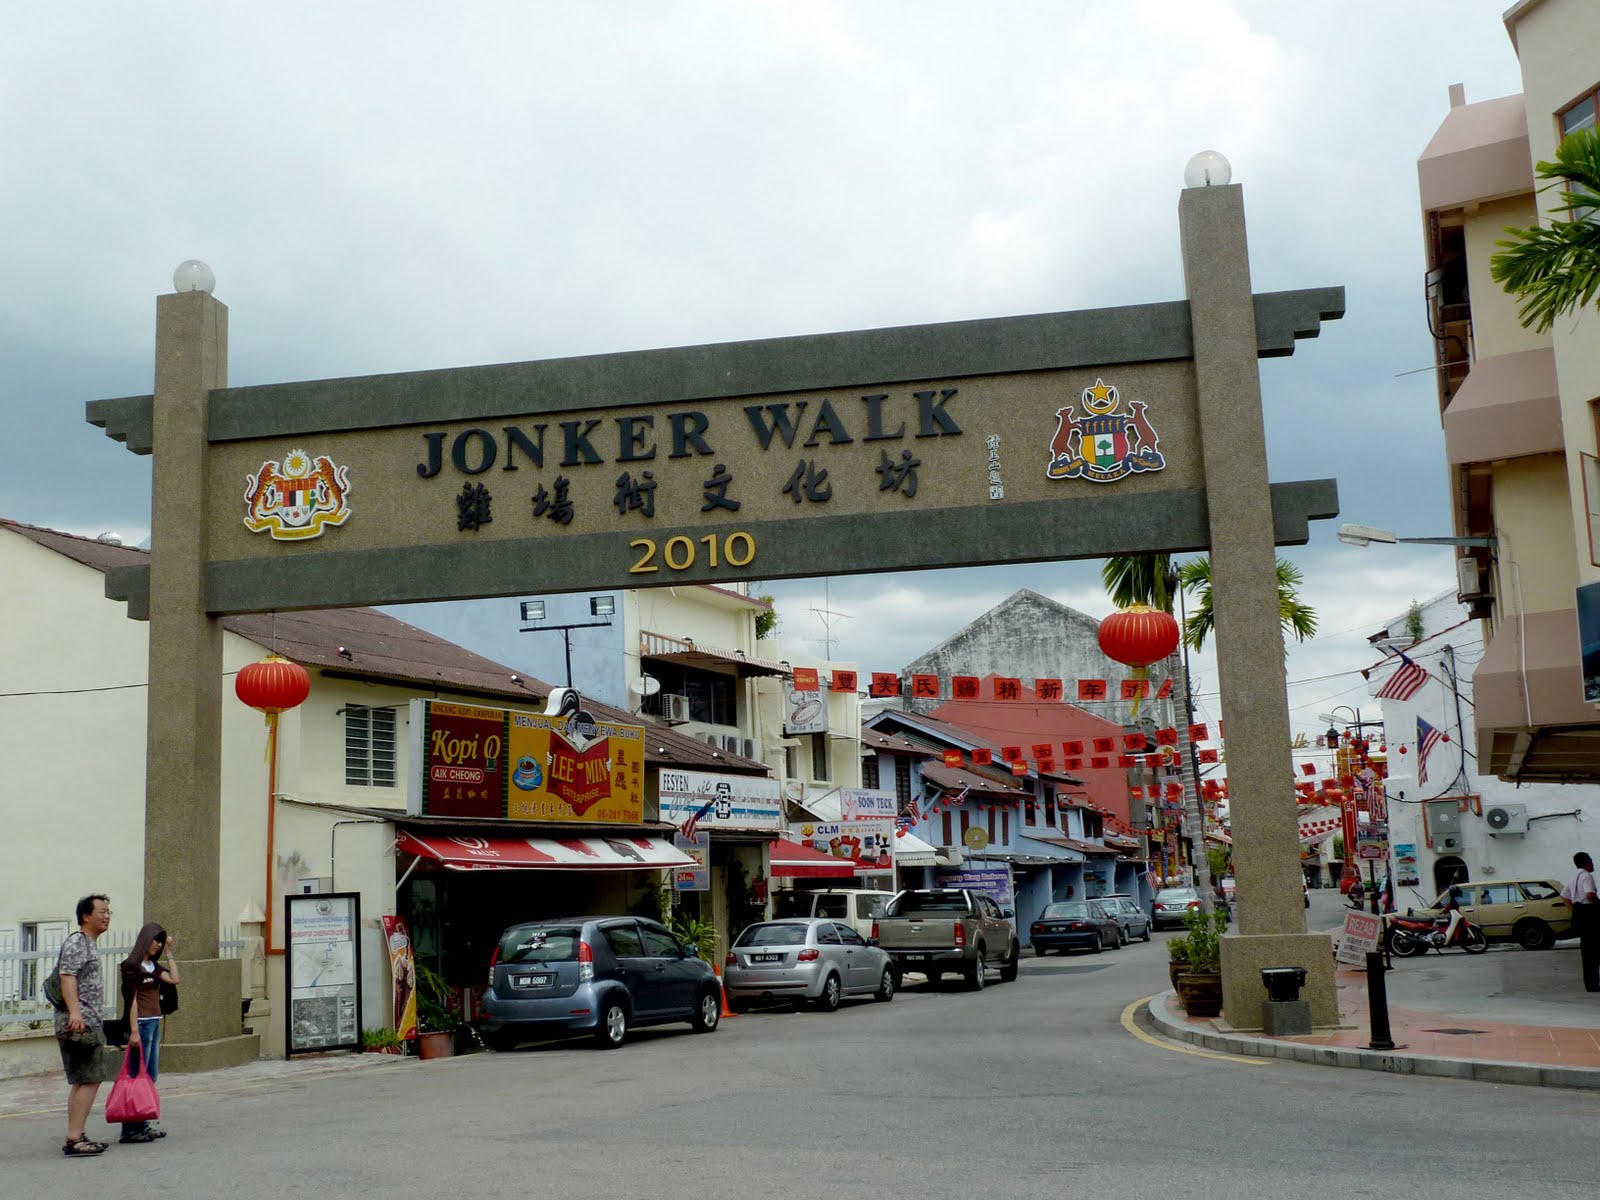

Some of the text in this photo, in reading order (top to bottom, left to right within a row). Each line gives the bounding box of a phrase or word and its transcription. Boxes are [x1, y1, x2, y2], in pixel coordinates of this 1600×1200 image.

[416, 388, 963, 479] JONKER WALK
[1088, 468, 1126, 479] MELAKA
[629, 531, 757, 574] 2010
[458, 708, 471, 717] KOPI
[514, 715, 554, 730] MENJUAL
[557, 720, 576, 735] DAN
[620, 728, 640, 740] BUKU
[431, 729, 501, 765] Kopi O
[434, 768, 481, 780] AIK CHEONG
[551, 753, 608, 784] LEE MIN
[663, 773, 689, 792] FESYEN
[562, 785, 600, 802] ENTERPRISE
[858, 797, 893, 809] SOON TECK
[817, 825, 839, 834] CLM
[1348, 917, 1375, 936] REZAB
